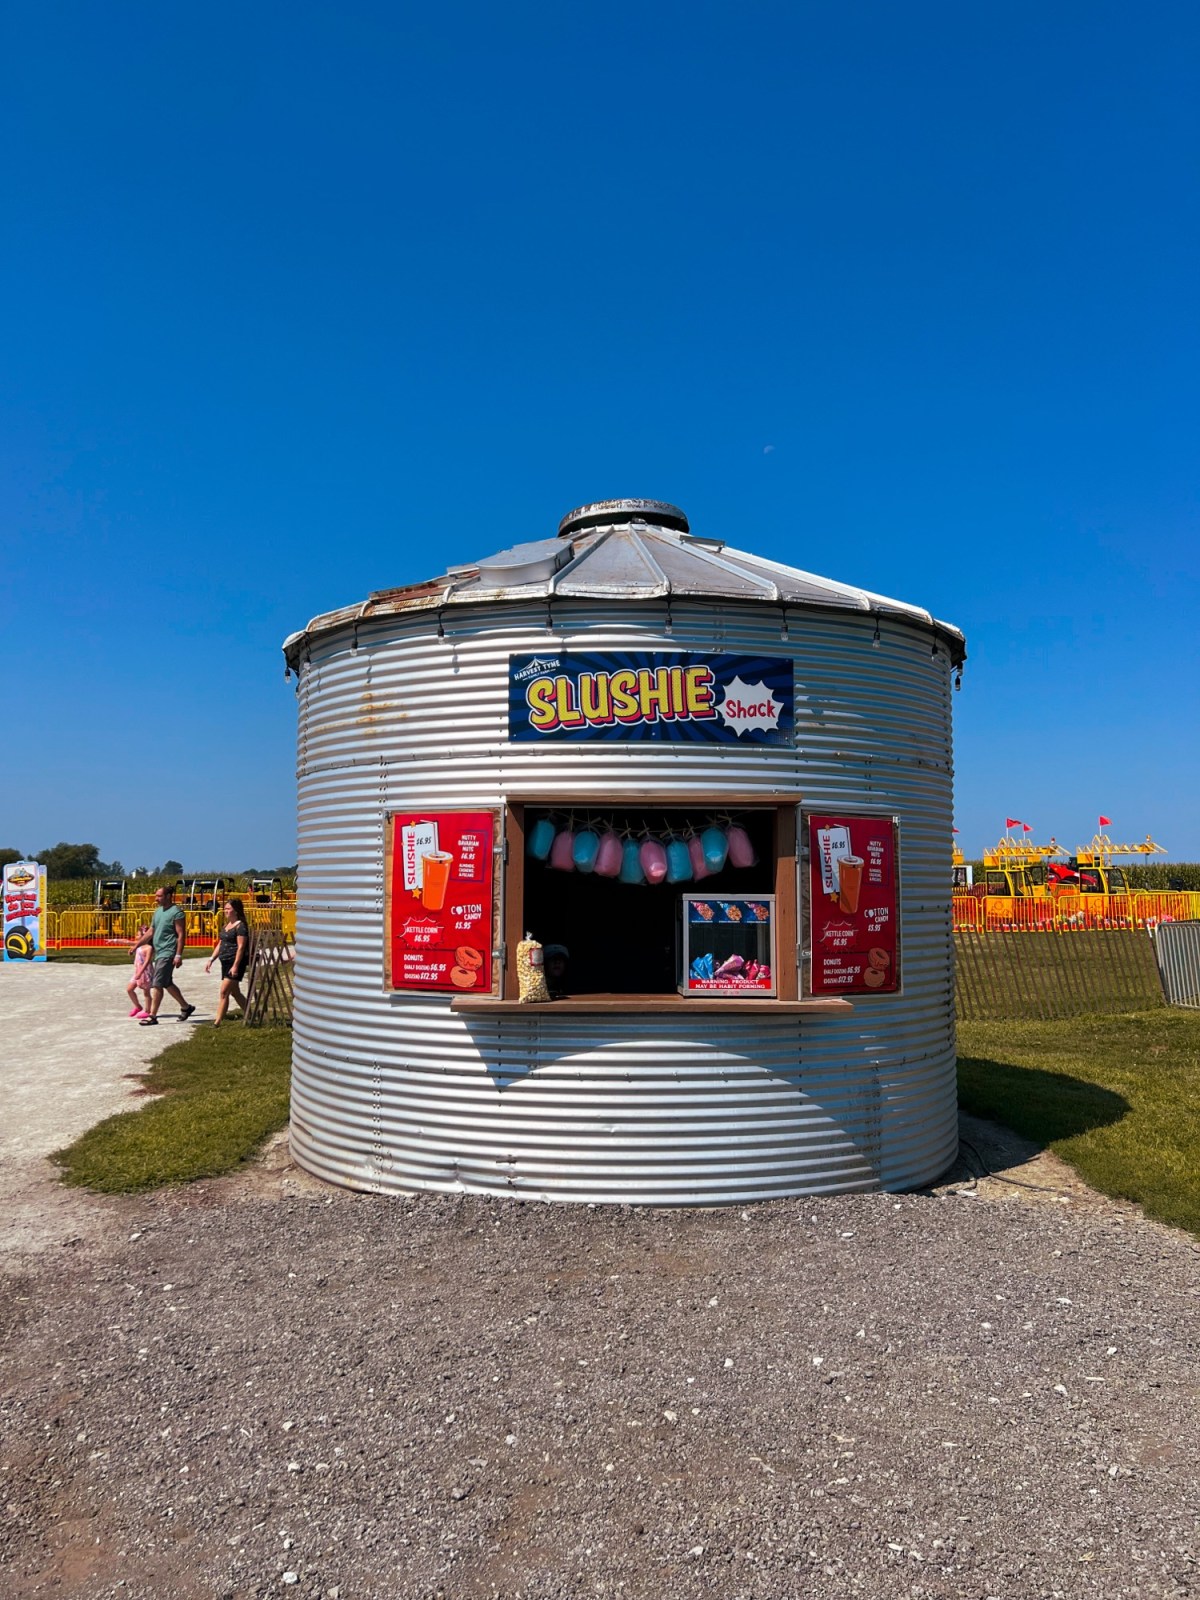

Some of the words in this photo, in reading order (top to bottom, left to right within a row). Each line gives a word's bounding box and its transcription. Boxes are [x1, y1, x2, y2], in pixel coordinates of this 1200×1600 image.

[514, 666, 541, 681] HARVEST
[543, 660, 561, 670] TYME
[527, 665, 717, 732] SLUSHIE
[725, 699, 776, 719] Shack
[416, 837, 432, 845] $6.95
[832, 841, 845, 849] $6.95
[407, 831, 416, 885] SLUSHIE
[823, 835, 833, 888] SLUSHIE
[450, 904, 482, 915] COTTON
[864, 907, 889, 918] COTTON
[463, 912, 482, 921] CANDY
[874, 915, 889, 923] CANDY
[455, 921, 472, 930] $5.95
[867, 924, 881, 932] $5.95
[414, 934, 431, 942] $6.95
[833, 938, 847, 946] $6.95
[430, 963, 447, 971] $6.95
[846, 966, 861, 974] $6.95
[420, 972, 438, 980] $12.95
[838, 975, 854, 983] $12.95
